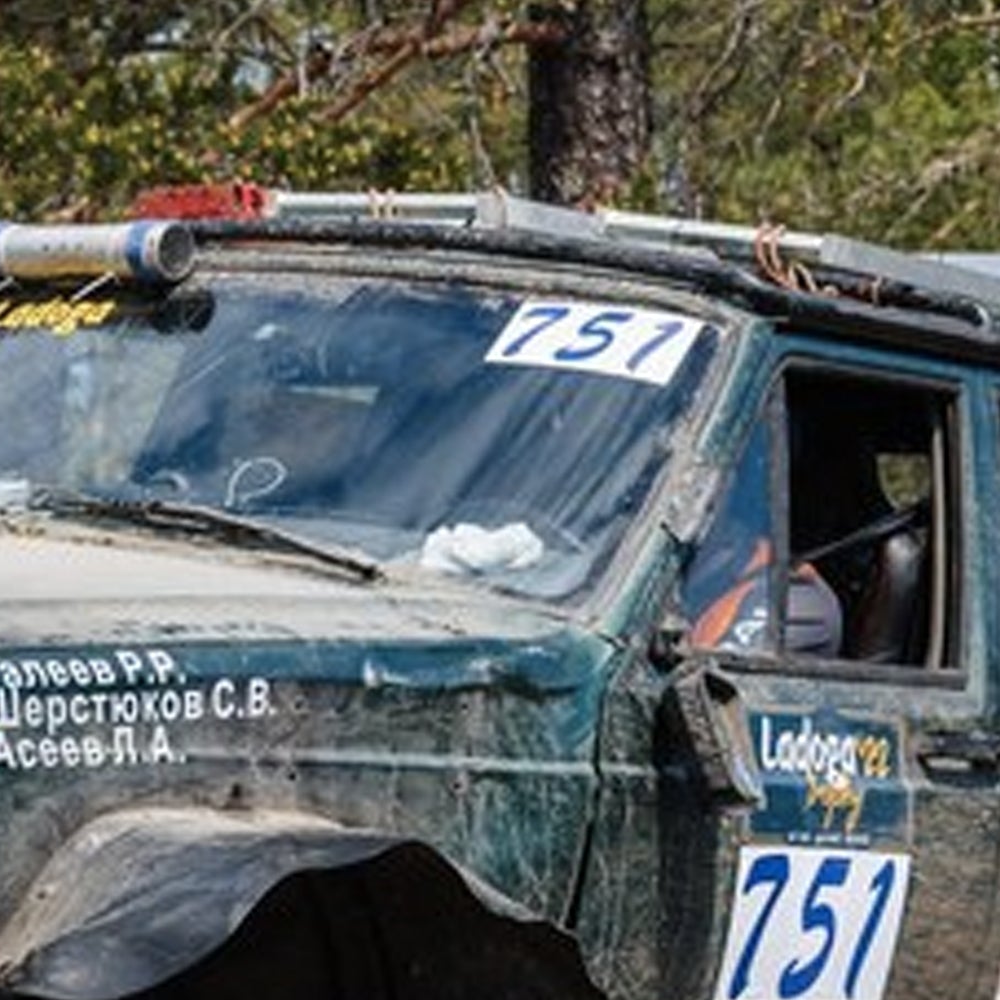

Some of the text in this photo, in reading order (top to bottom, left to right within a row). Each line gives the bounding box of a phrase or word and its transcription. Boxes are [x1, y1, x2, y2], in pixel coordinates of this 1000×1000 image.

[501, 307, 685, 371] 751
[115, 650, 187, 685] Р.Р.
[212, 678, 278, 720] С.В.
[728, 855, 896, 1000] 751
